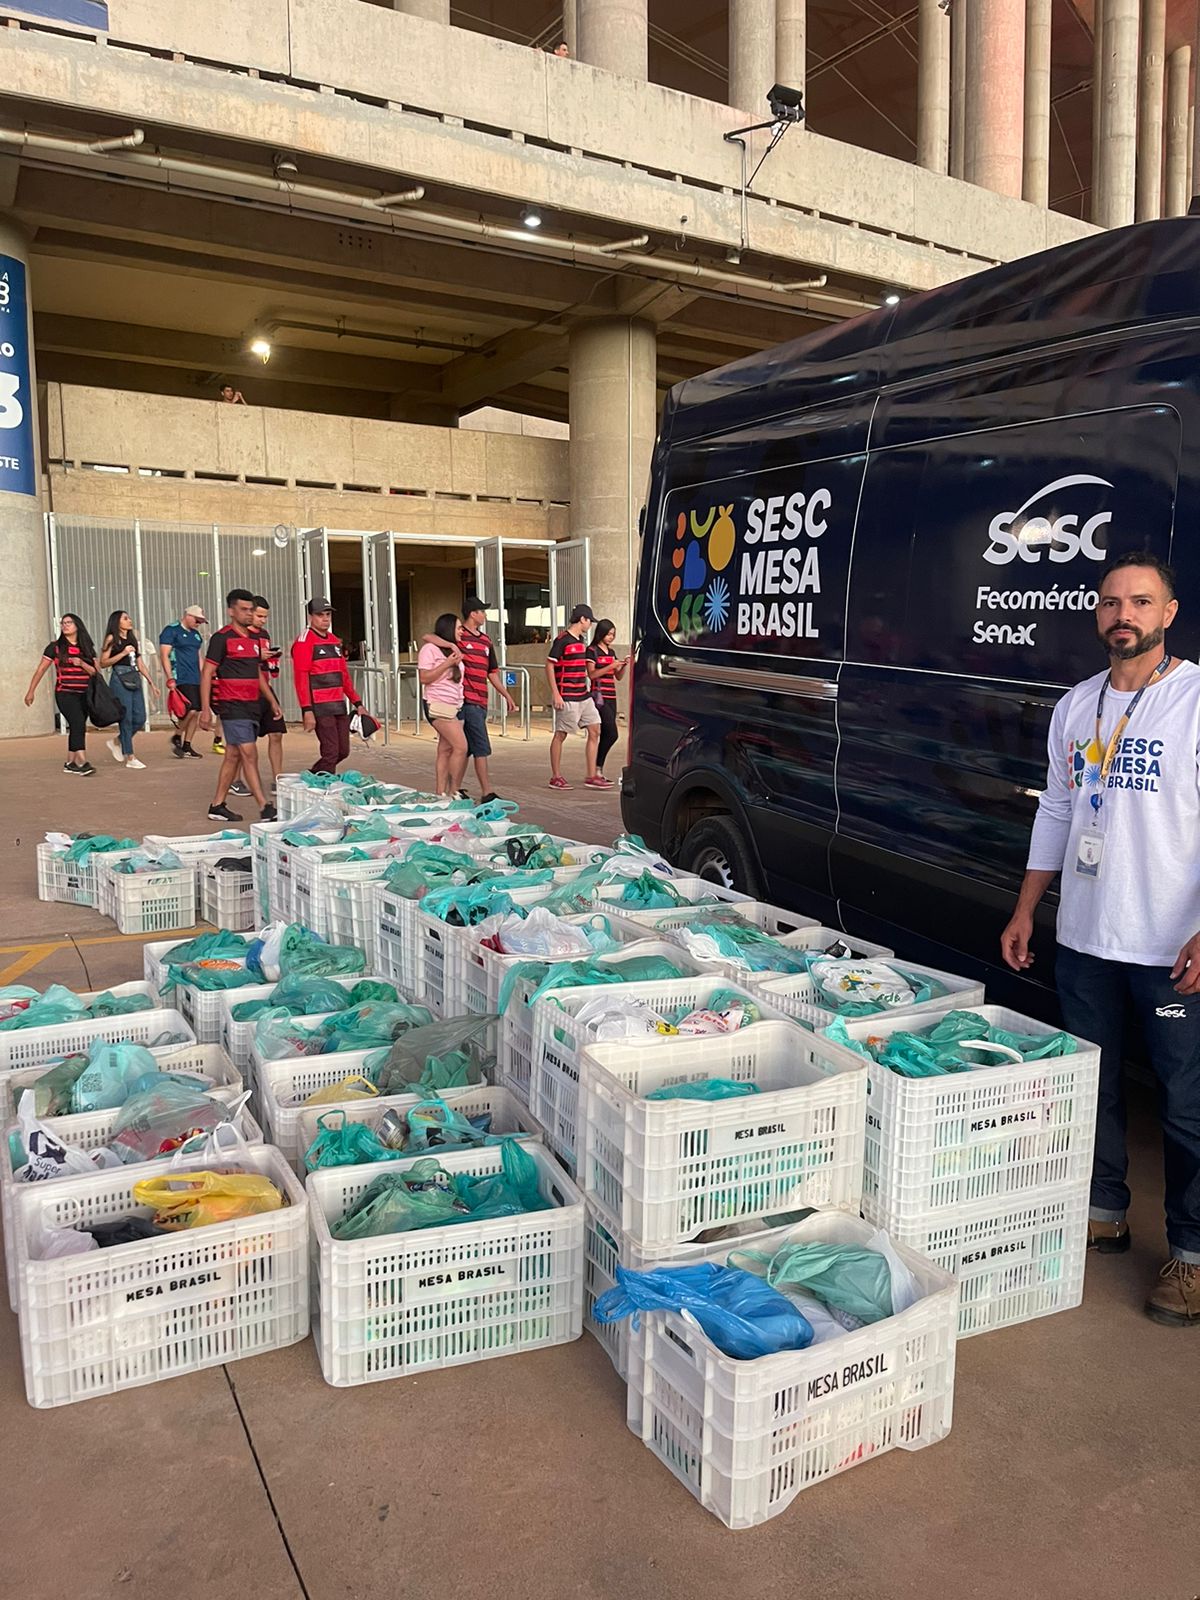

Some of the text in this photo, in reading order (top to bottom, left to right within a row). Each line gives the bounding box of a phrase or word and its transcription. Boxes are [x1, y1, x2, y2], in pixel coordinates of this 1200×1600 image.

[743, 488, 832, 545] SESC
[739, 547, 821, 596] MESA
[976, 584, 1100, 611] Fecomércio
[737, 602, 819, 638] BRASIL
[1110, 757, 1161, 777] MESA
[1107, 776, 1159, 793] BRASIL
[735, 1123, 786, 1141] MESA BRASIL
[970, 1111, 1037, 1132] MESA BRASIL
[961, 1241, 1027, 1266] MESA BRASIL
[126, 1271, 222, 1303] MESA BRASIL
[418, 1265, 506, 1289] MESA BRASIL
[807, 1353, 889, 1402] MESA BRASIL
